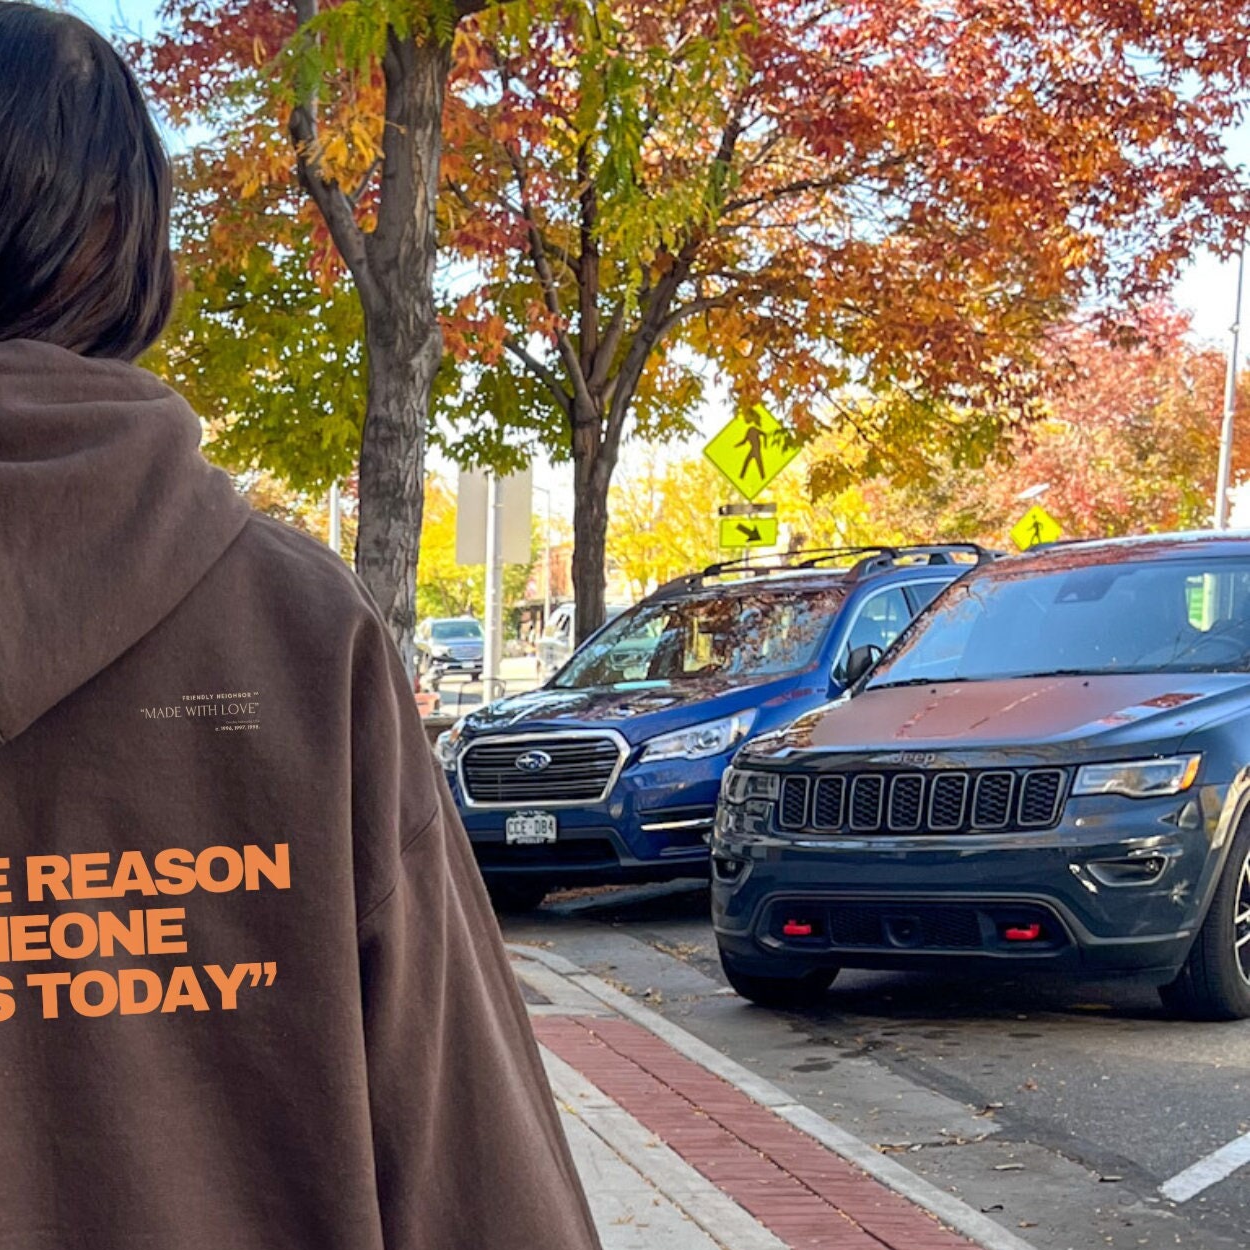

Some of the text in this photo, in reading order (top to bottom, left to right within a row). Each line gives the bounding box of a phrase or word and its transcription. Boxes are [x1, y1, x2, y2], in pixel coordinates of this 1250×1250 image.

[185, 704, 217, 717] WITH
[890, 751, 936, 765] Jeep
[26, 843, 291, 902] REASON
[26, 961, 278, 1019] TODAY”
